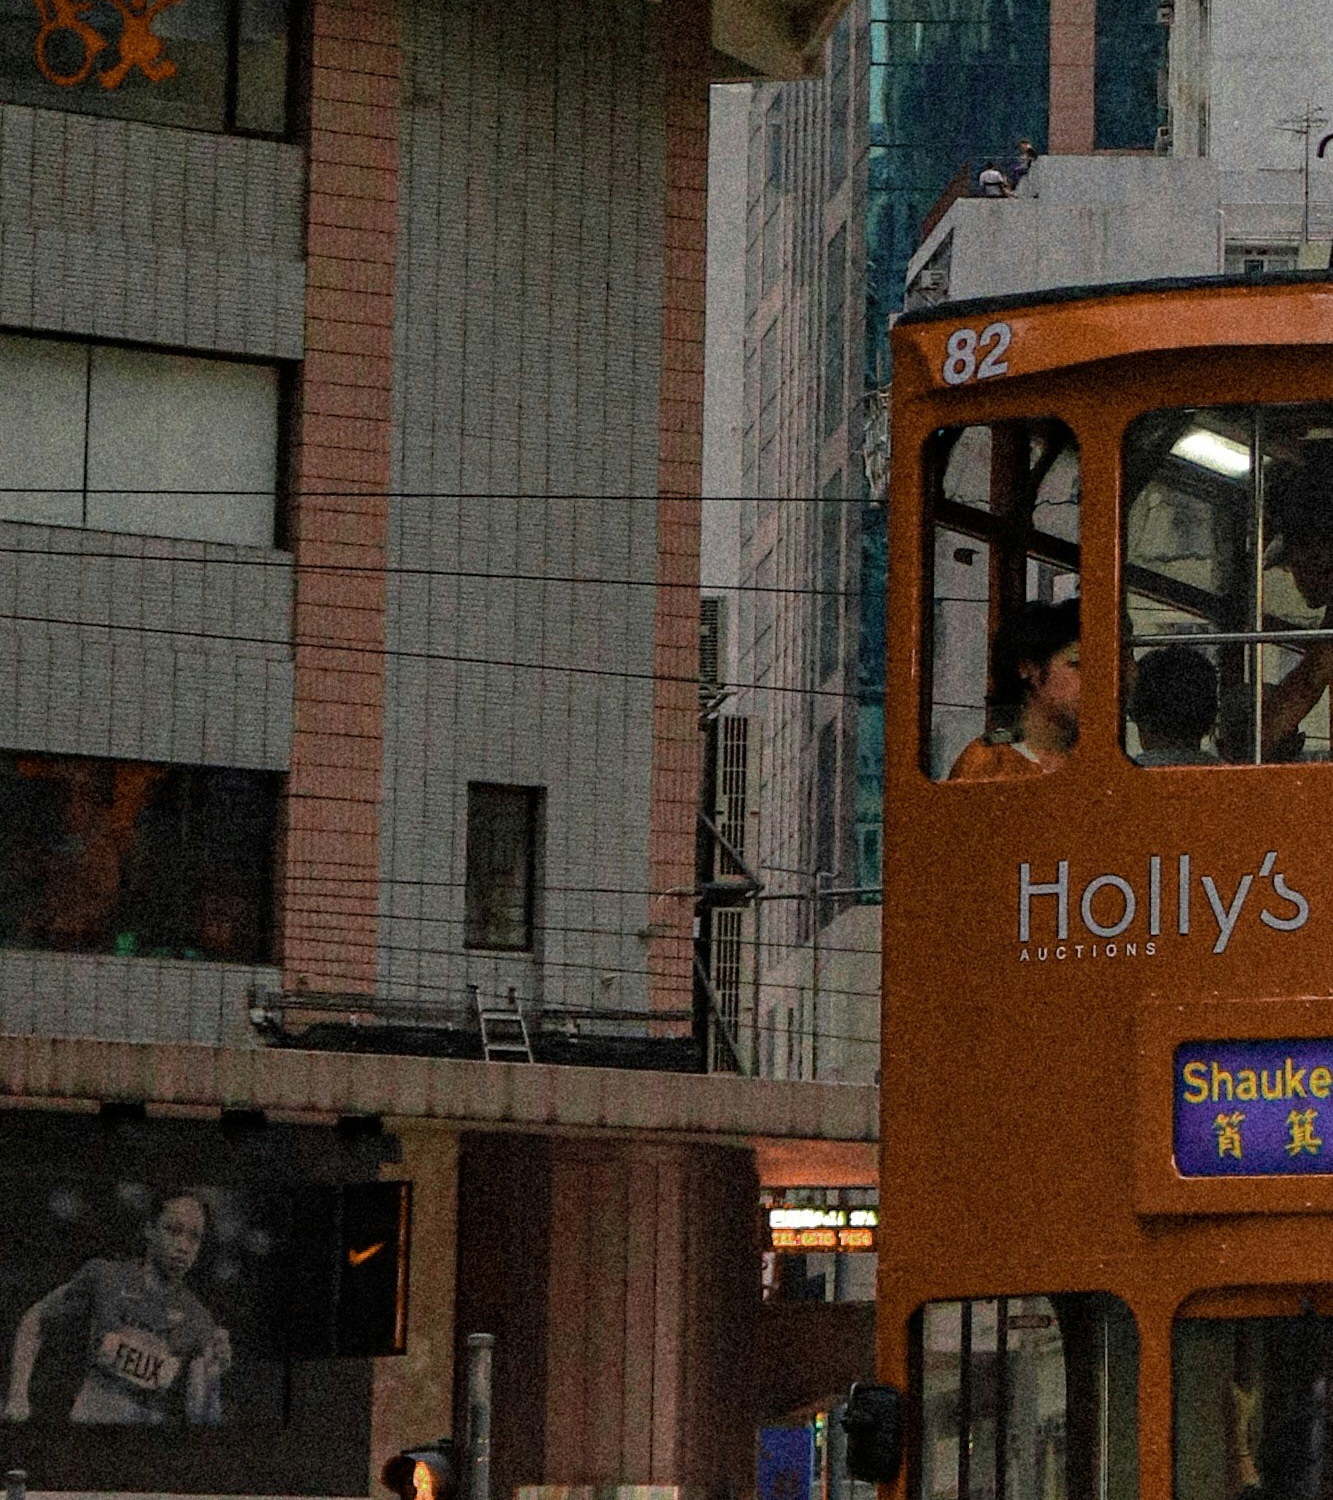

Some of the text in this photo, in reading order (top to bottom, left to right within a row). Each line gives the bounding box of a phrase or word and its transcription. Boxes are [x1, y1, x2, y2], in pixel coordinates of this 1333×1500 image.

[942, 321, 1012, 386] 82
[1018, 852, 1310, 955] Holly's
[1018, 942, 1159, 962] AUCTIONS
[114, 1343, 164, 1386] FELIX
